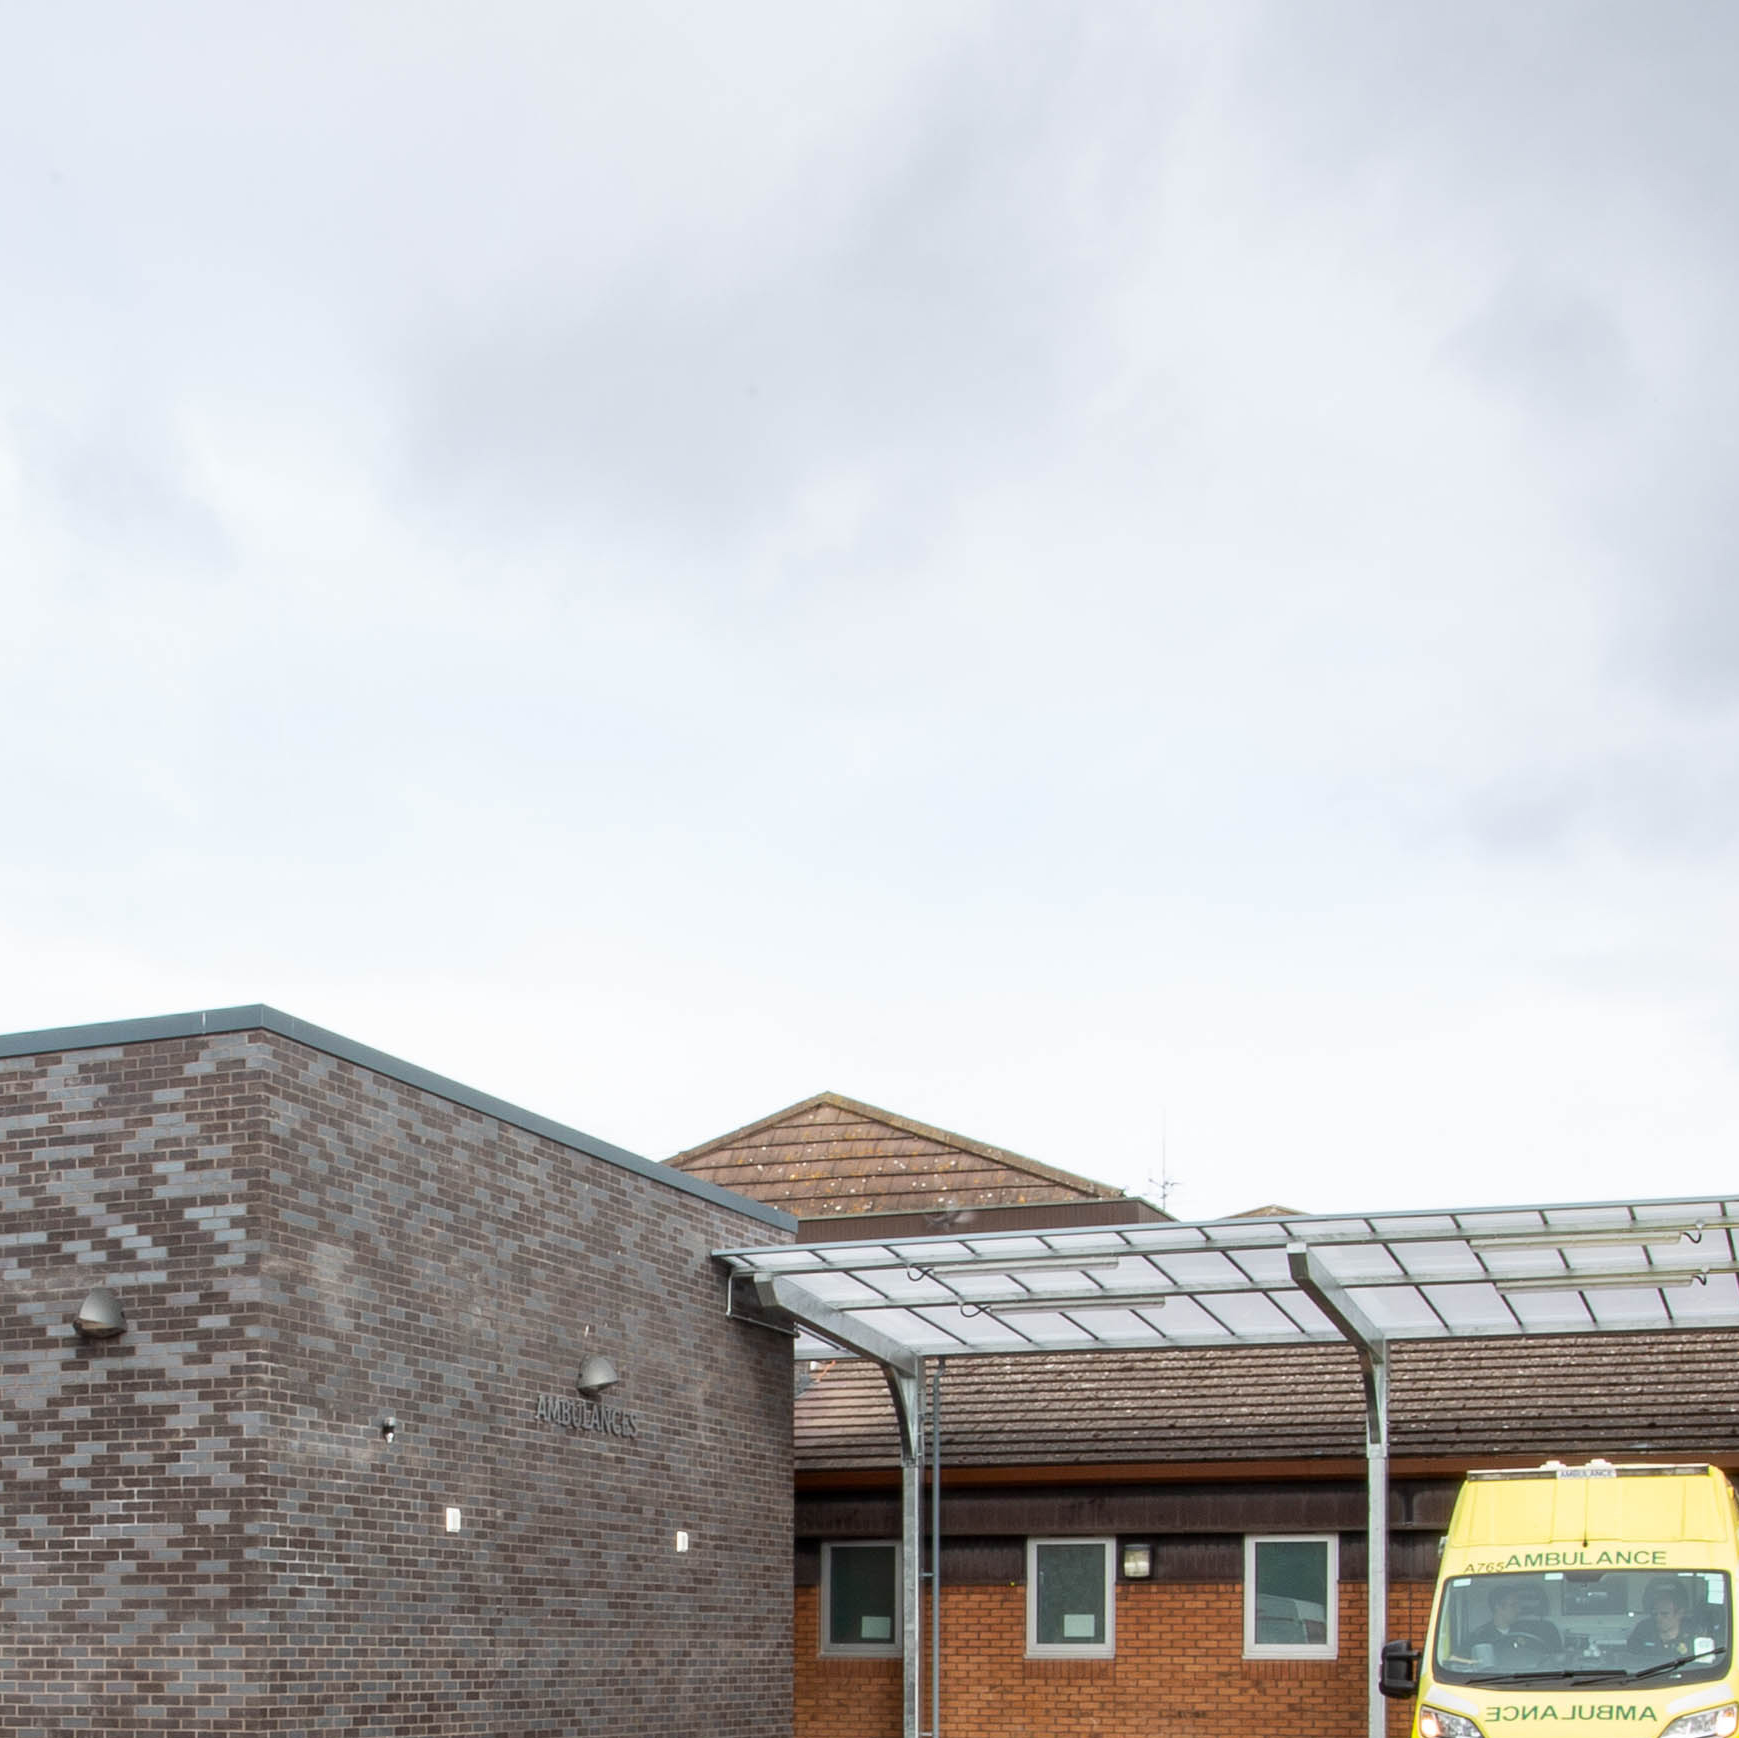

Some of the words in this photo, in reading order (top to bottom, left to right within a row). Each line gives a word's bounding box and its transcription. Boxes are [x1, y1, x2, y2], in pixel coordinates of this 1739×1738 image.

[535, 1395, 638, 1438] AMBULANCES
[1464, 1562, 1505, 1574] A765
[1505, 1550, 1667, 1569] AMBULANCE
